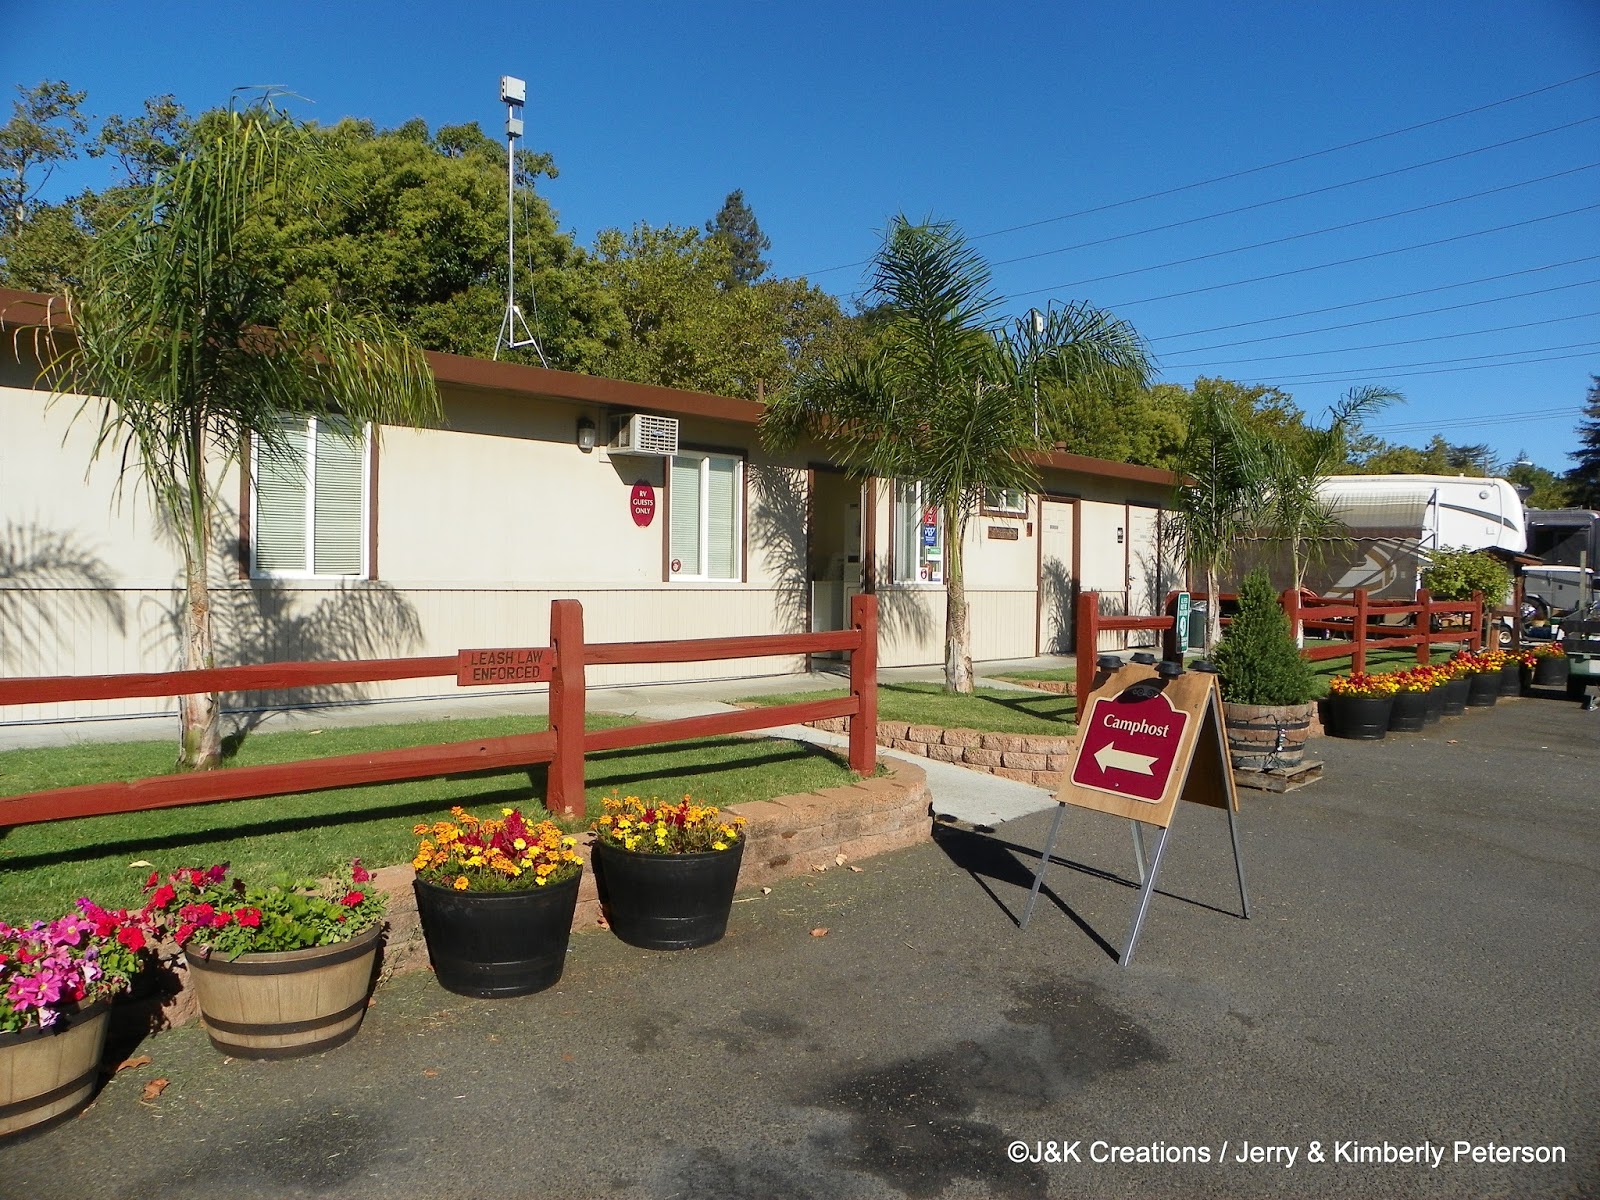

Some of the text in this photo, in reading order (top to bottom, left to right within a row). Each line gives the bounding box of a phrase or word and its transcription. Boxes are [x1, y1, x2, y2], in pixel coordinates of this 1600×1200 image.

[632, 498, 654, 506] GUESTS
[635, 507, 651, 515] ONLY
[470, 651, 543, 666] LEASH LAW
[473, 666, 540, 681] ENFORCED
[1103, 714, 1169, 737] Camphost
